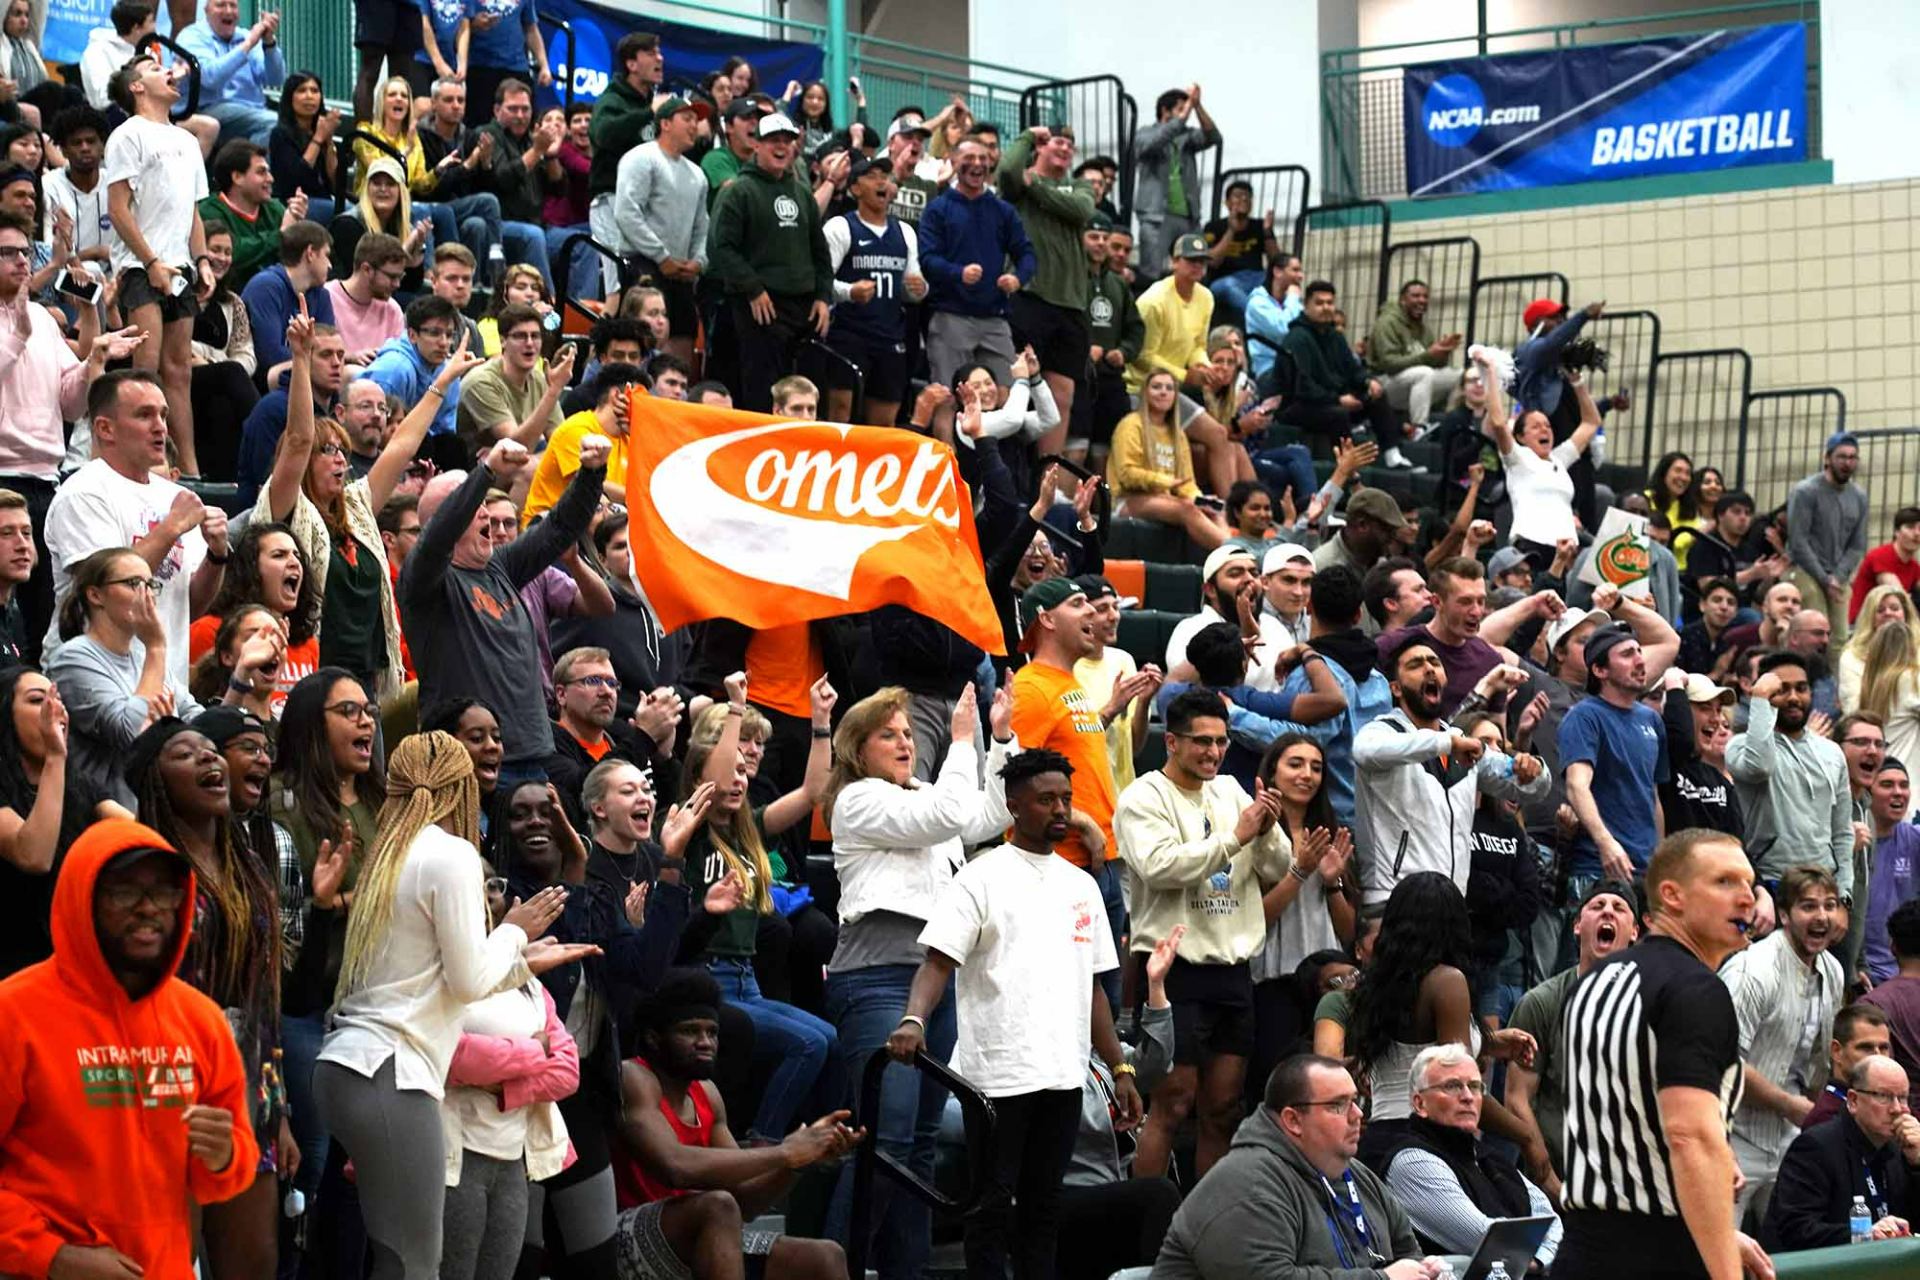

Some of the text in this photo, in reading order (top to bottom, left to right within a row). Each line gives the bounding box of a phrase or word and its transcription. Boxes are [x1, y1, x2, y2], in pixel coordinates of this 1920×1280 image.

[1428, 105, 1540, 131] NCAA.com
[1591, 108, 1794, 166] BASKETBALL
[870, 272, 893, 298] 77
